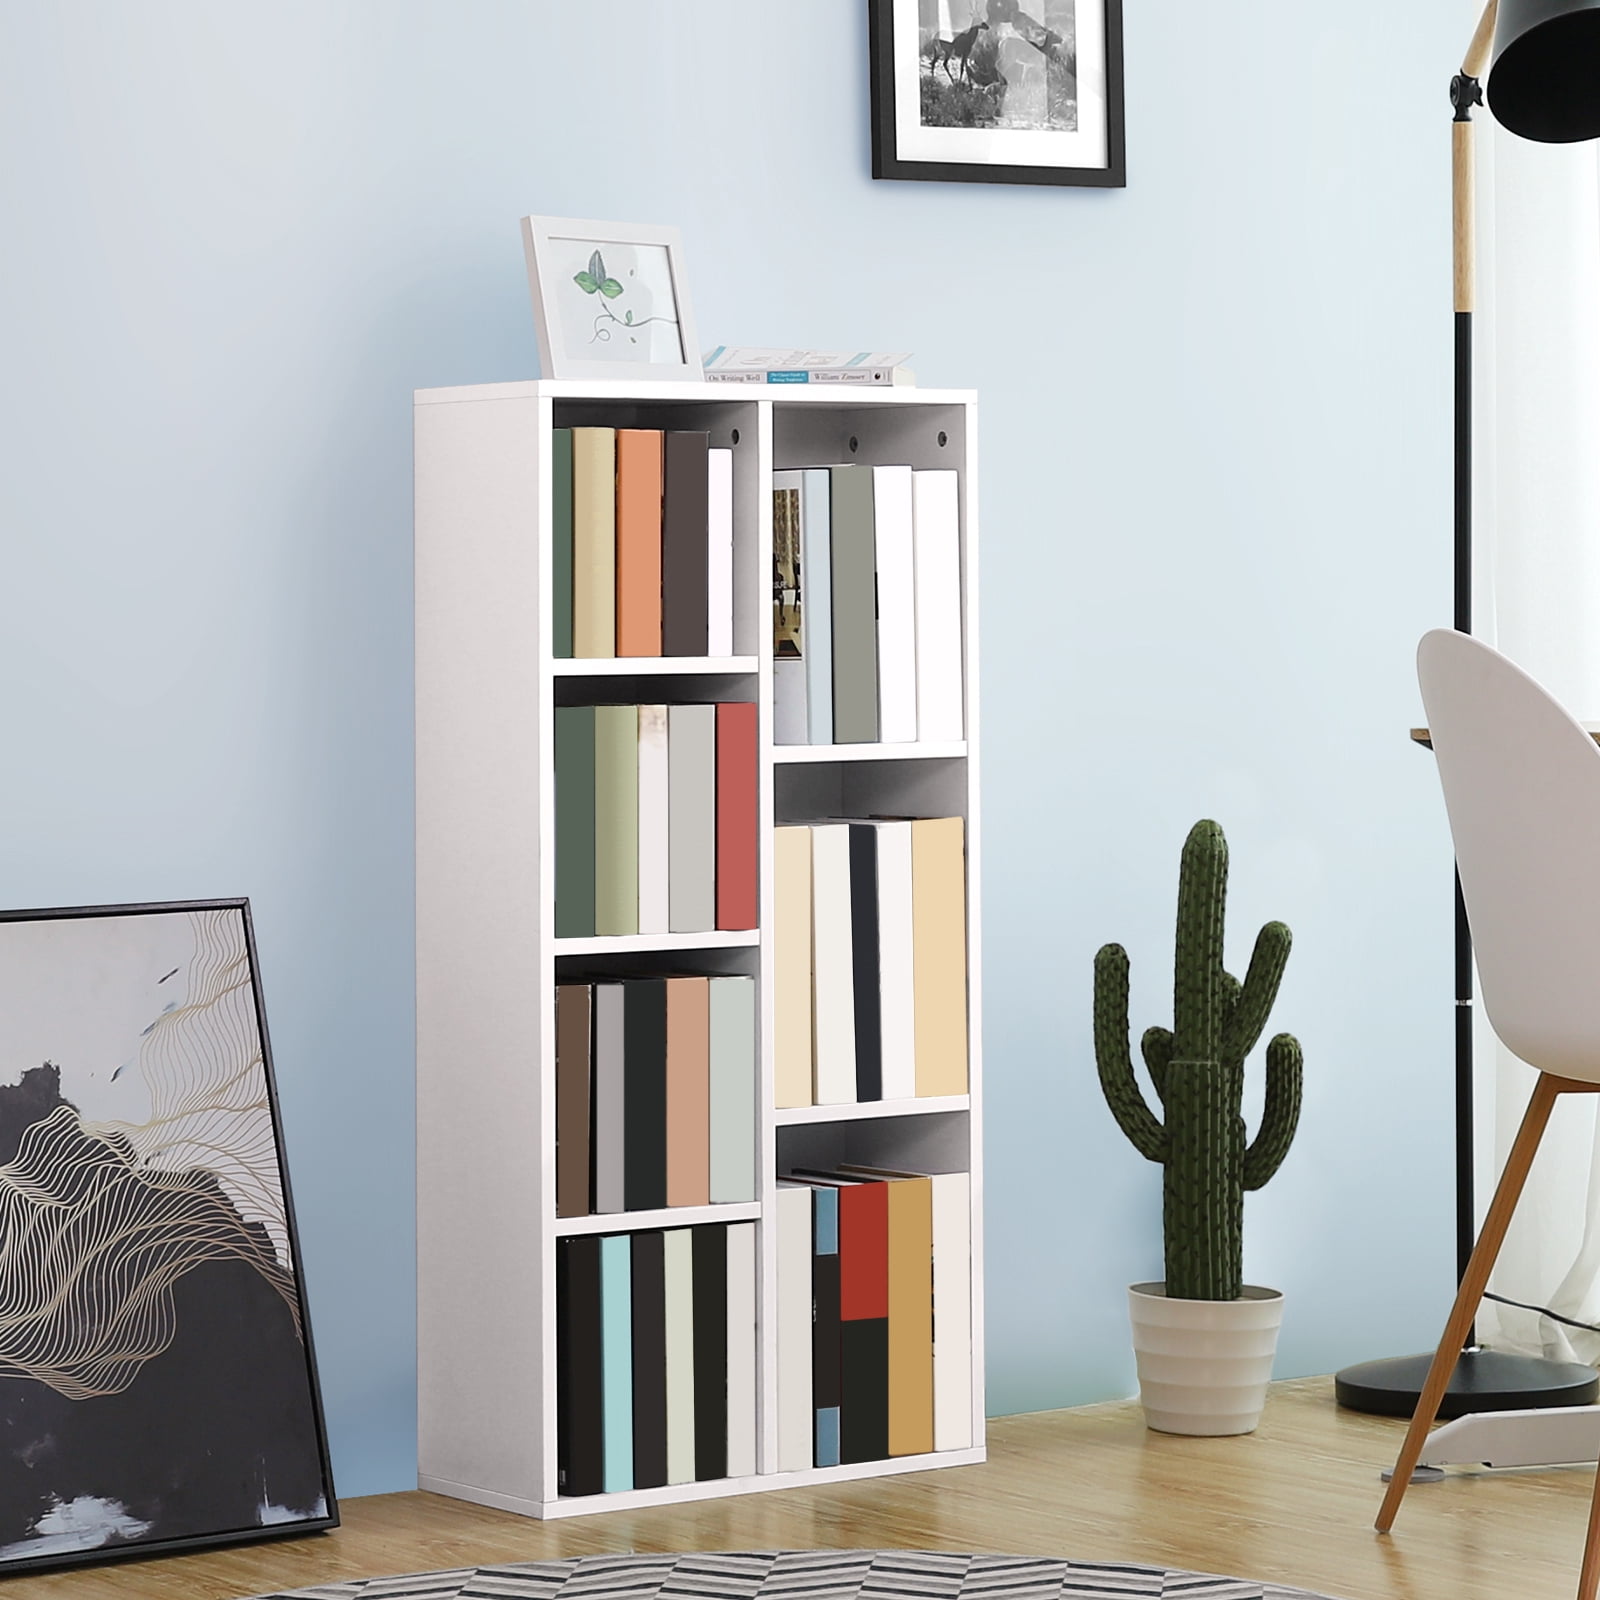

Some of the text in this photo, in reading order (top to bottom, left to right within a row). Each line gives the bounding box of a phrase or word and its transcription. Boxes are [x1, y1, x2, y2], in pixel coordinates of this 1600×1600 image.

[720, 374, 745, 382] Writing
[746, 373, 761, 381] Well
[814, 372, 840, 380] William
